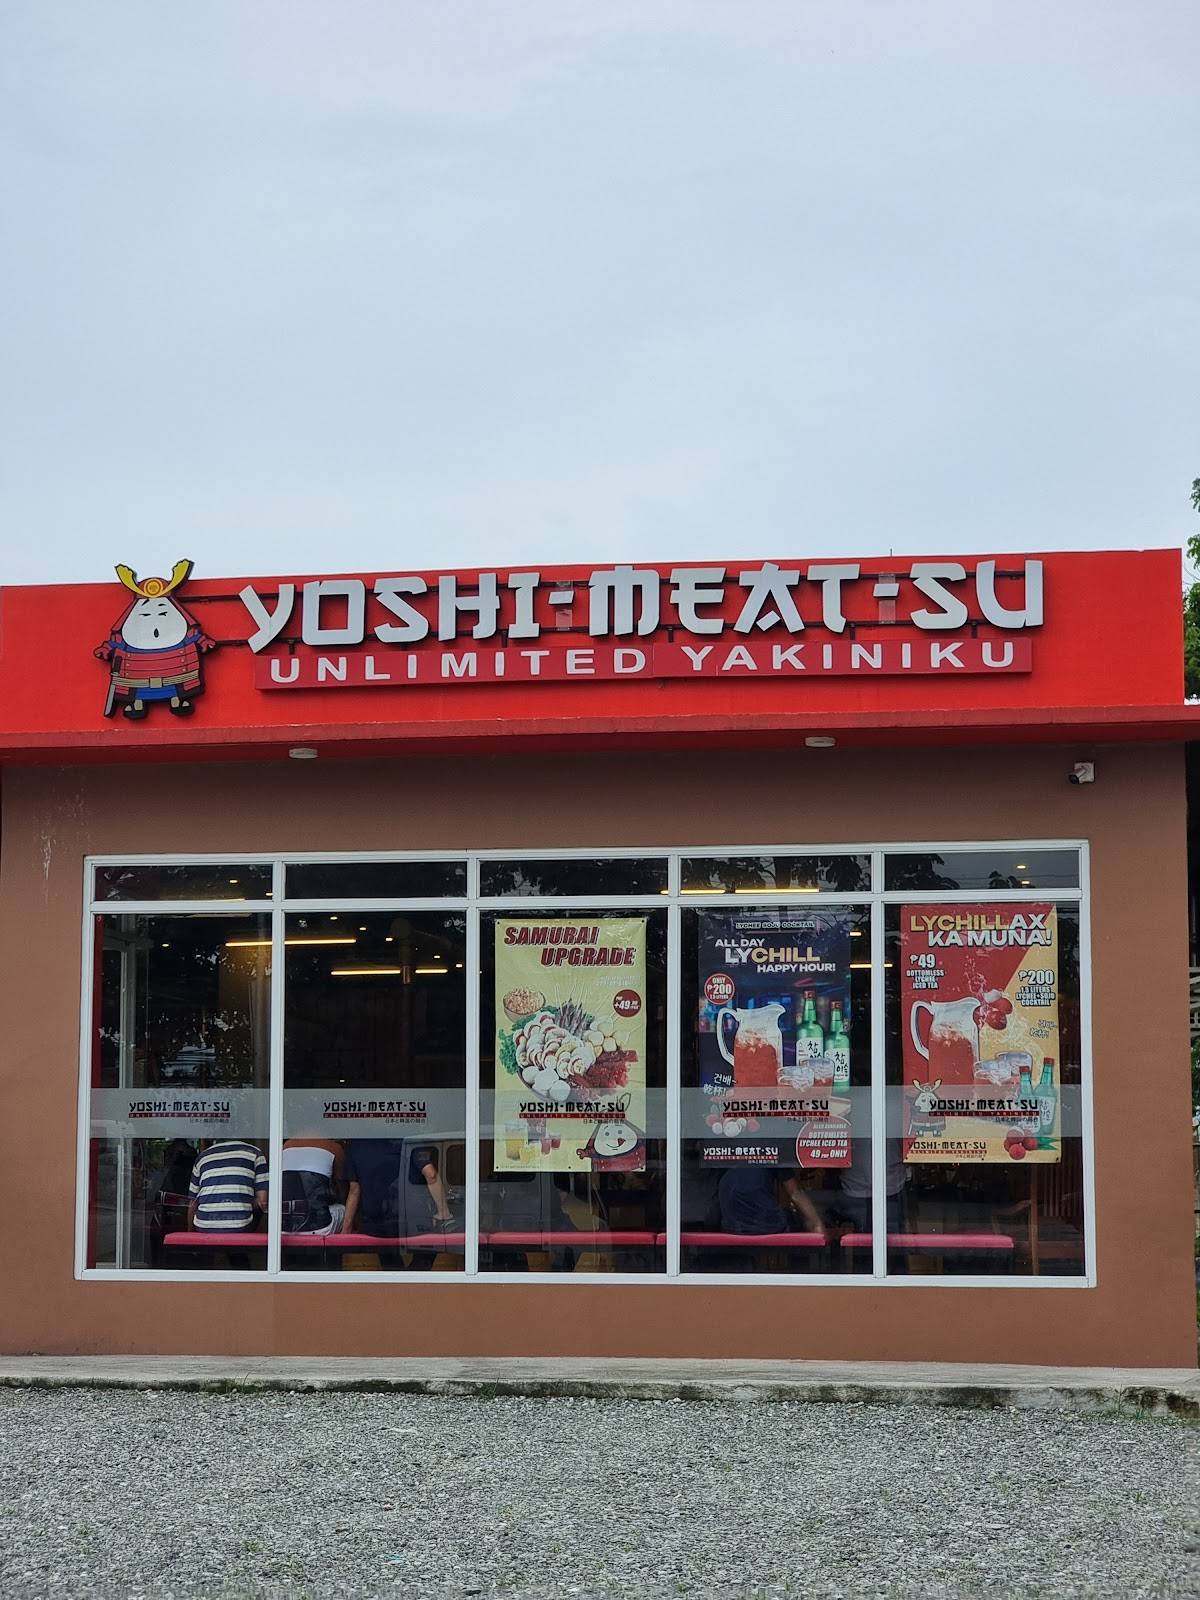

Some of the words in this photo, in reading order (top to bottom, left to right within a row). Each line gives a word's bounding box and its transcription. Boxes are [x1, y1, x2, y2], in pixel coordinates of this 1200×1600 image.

[238, 560, 1043, 653] YOSHI-MEAT-SU
[271, 648, 646, 683] UNLIMITED
[681, 641, 1015, 671] YAKINIKU
[911, 914, 1046, 931] LYCHILLAX
[504, 926, 600, 945] SAMURAI
[928, 930, 964, 947] KA
[968, 929, 1052, 947] MUNA!
[715, 939, 739, 947] ALL
[741, 938, 765, 947] DAY
[540, 947, 636, 966] UPGRADE
[725, 947, 820, 964] LYCHILL
[757, 964, 797, 973] HAPPY
[799, 963, 836, 972] HOUR!
[129, 1101, 230, 1112] YOSHI-MEAT-SU
[324, 1101, 426, 1112] YOSHI-MEAT-SU
[519, 1101, 625, 1112] YOSHI-MEAT-SU
[723, 1099, 829, 1112] YOSHI-MEAT-SU
[929, 1099, 1038, 1110] YOSHI-MEAT-SU
[810, 1149, 821, 1158] 49
[829, 1149, 848, 1158] ONLY
